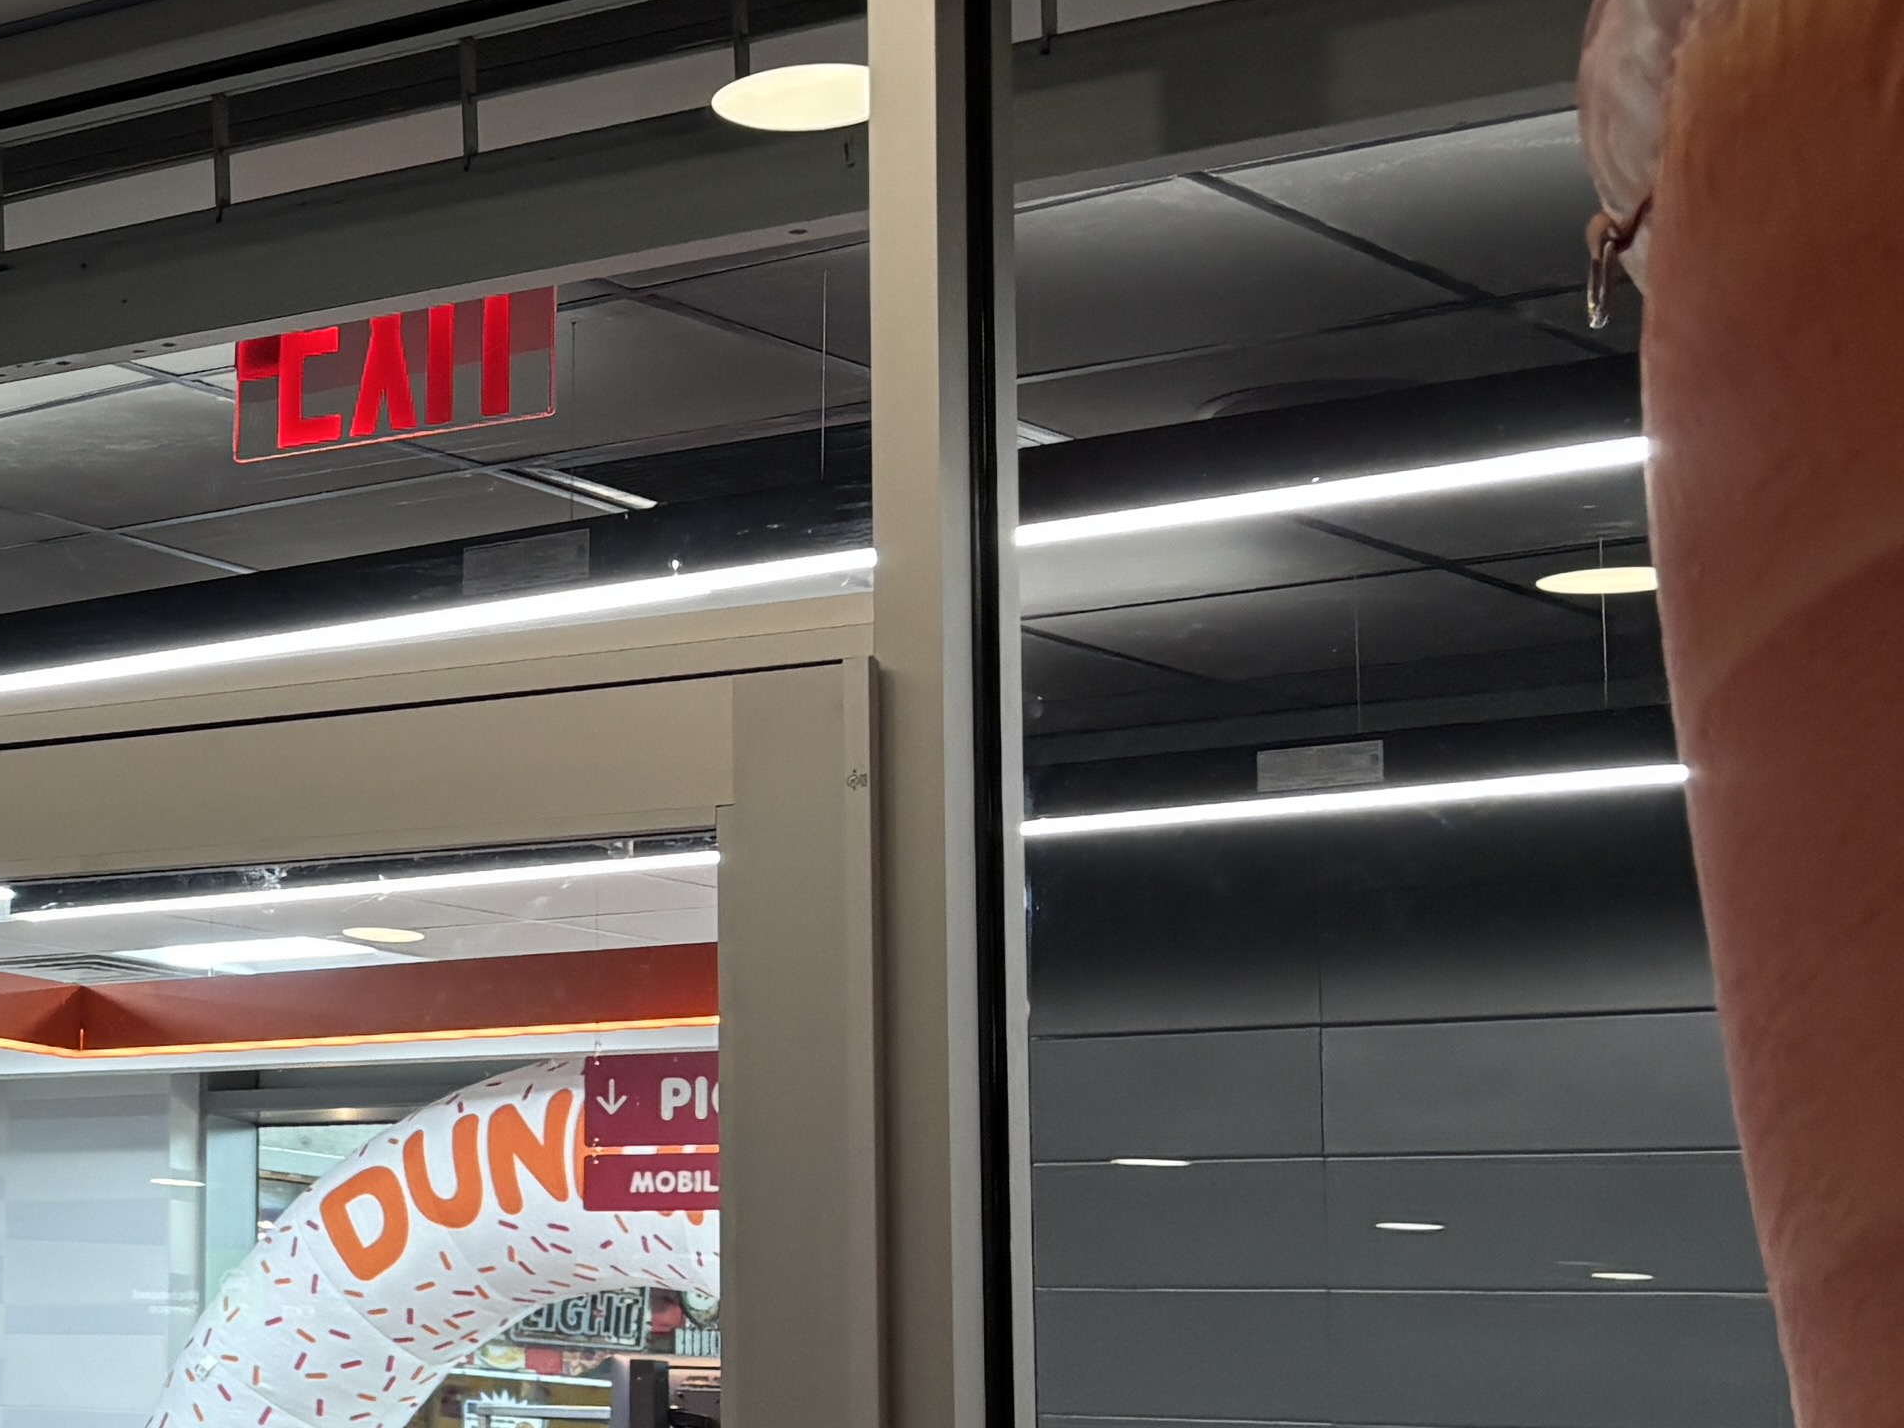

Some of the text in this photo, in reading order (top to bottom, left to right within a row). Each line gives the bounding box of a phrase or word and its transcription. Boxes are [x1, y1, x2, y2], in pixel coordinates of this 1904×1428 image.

[660, 1075, 719, 1121] PI
[319, 1087, 586, 1281] DUN
[629, 1170, 719, 1195] MOBIL
